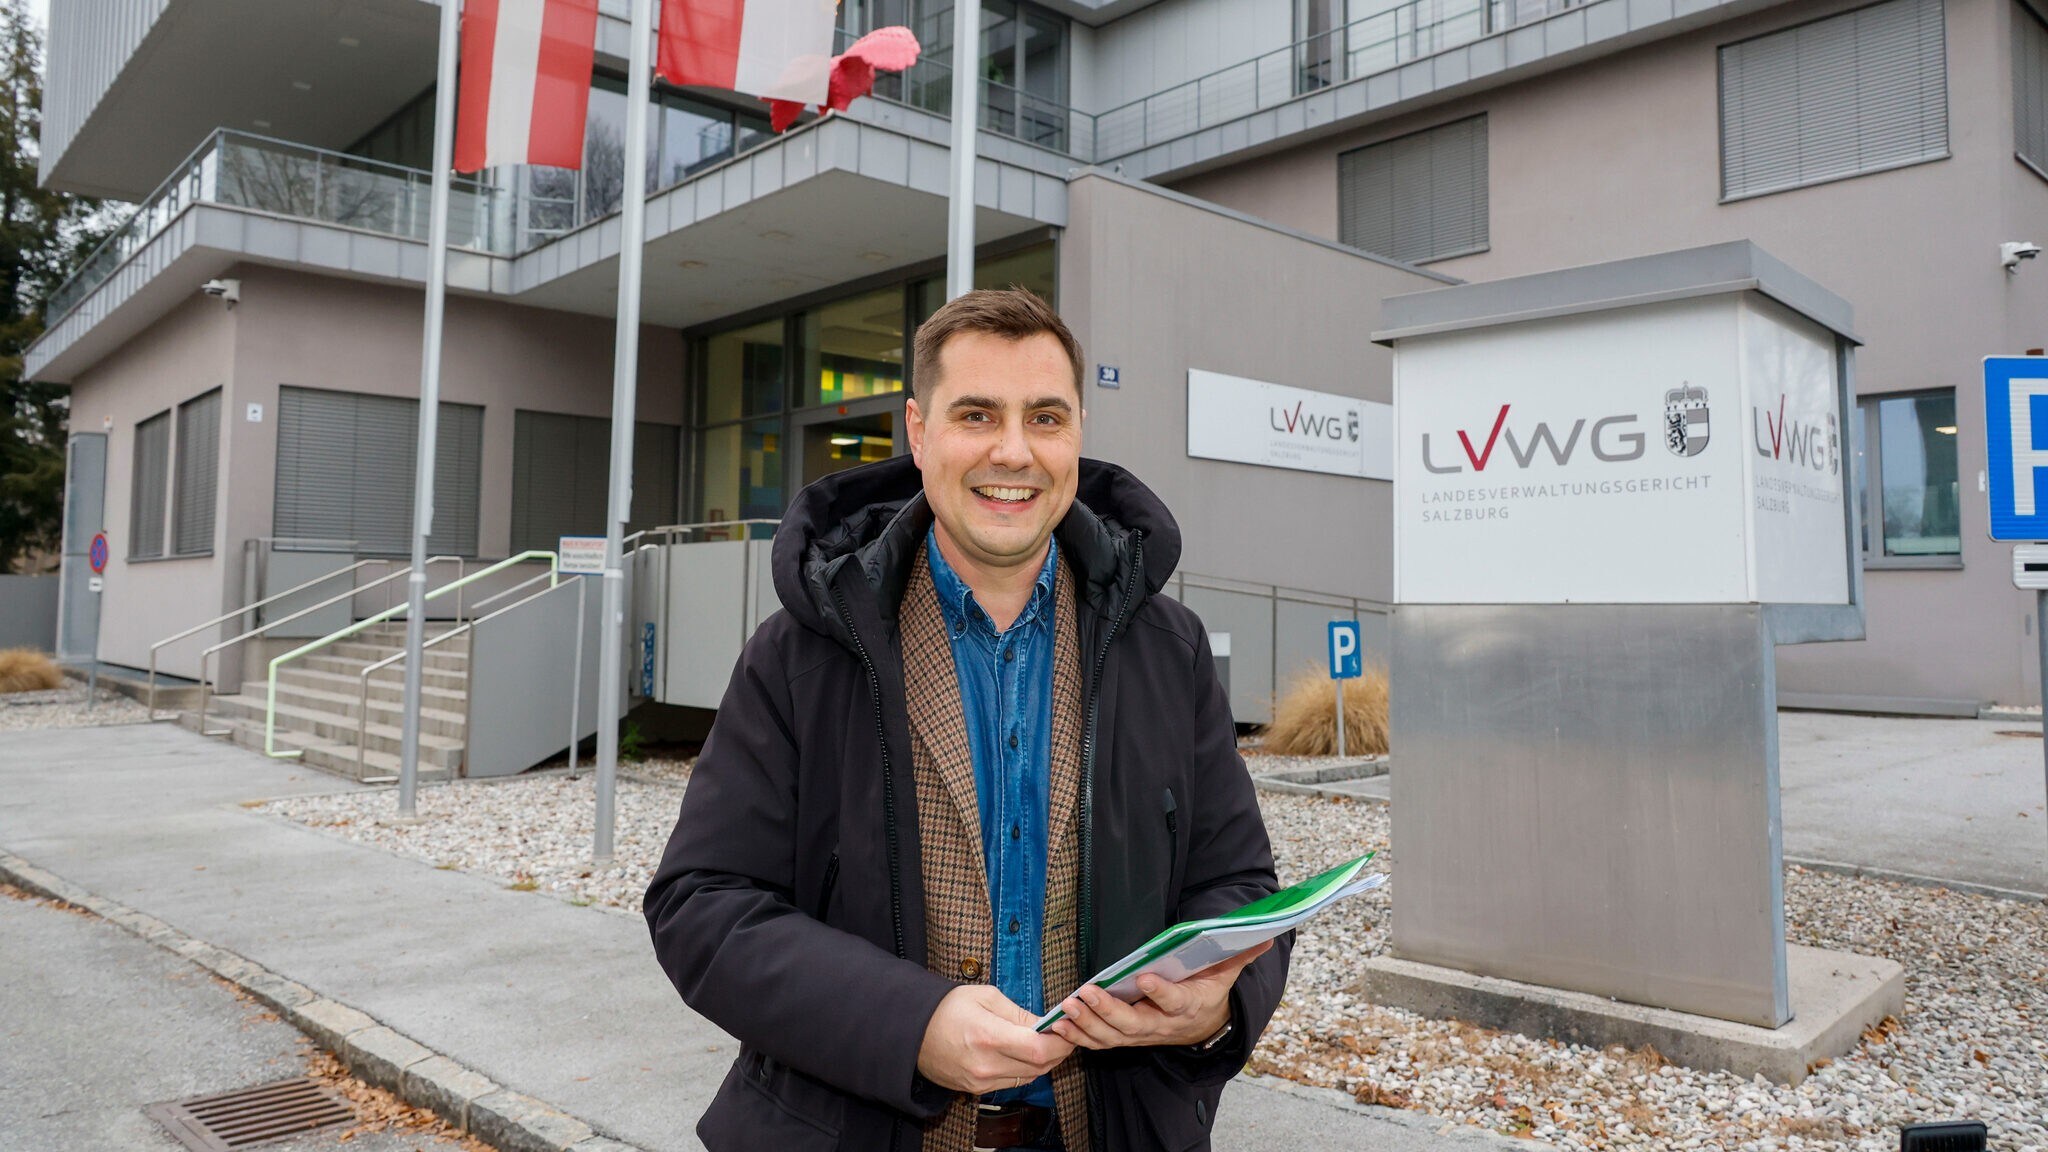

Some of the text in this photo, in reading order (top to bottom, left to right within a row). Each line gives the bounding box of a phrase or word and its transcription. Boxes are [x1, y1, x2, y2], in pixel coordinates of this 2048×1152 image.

[1270, 400, 1342, 440] LVWG
[1421, 403, 1646, 474] LVWG
[1753, 393, 1825, 471] LVWG
[1421, 474, 1712, 504] LANDESVERWALTUNGSGERICHT
[1421, 506, 1510, 522] SALZBURG
[1333, 626, 1356, 673] P
